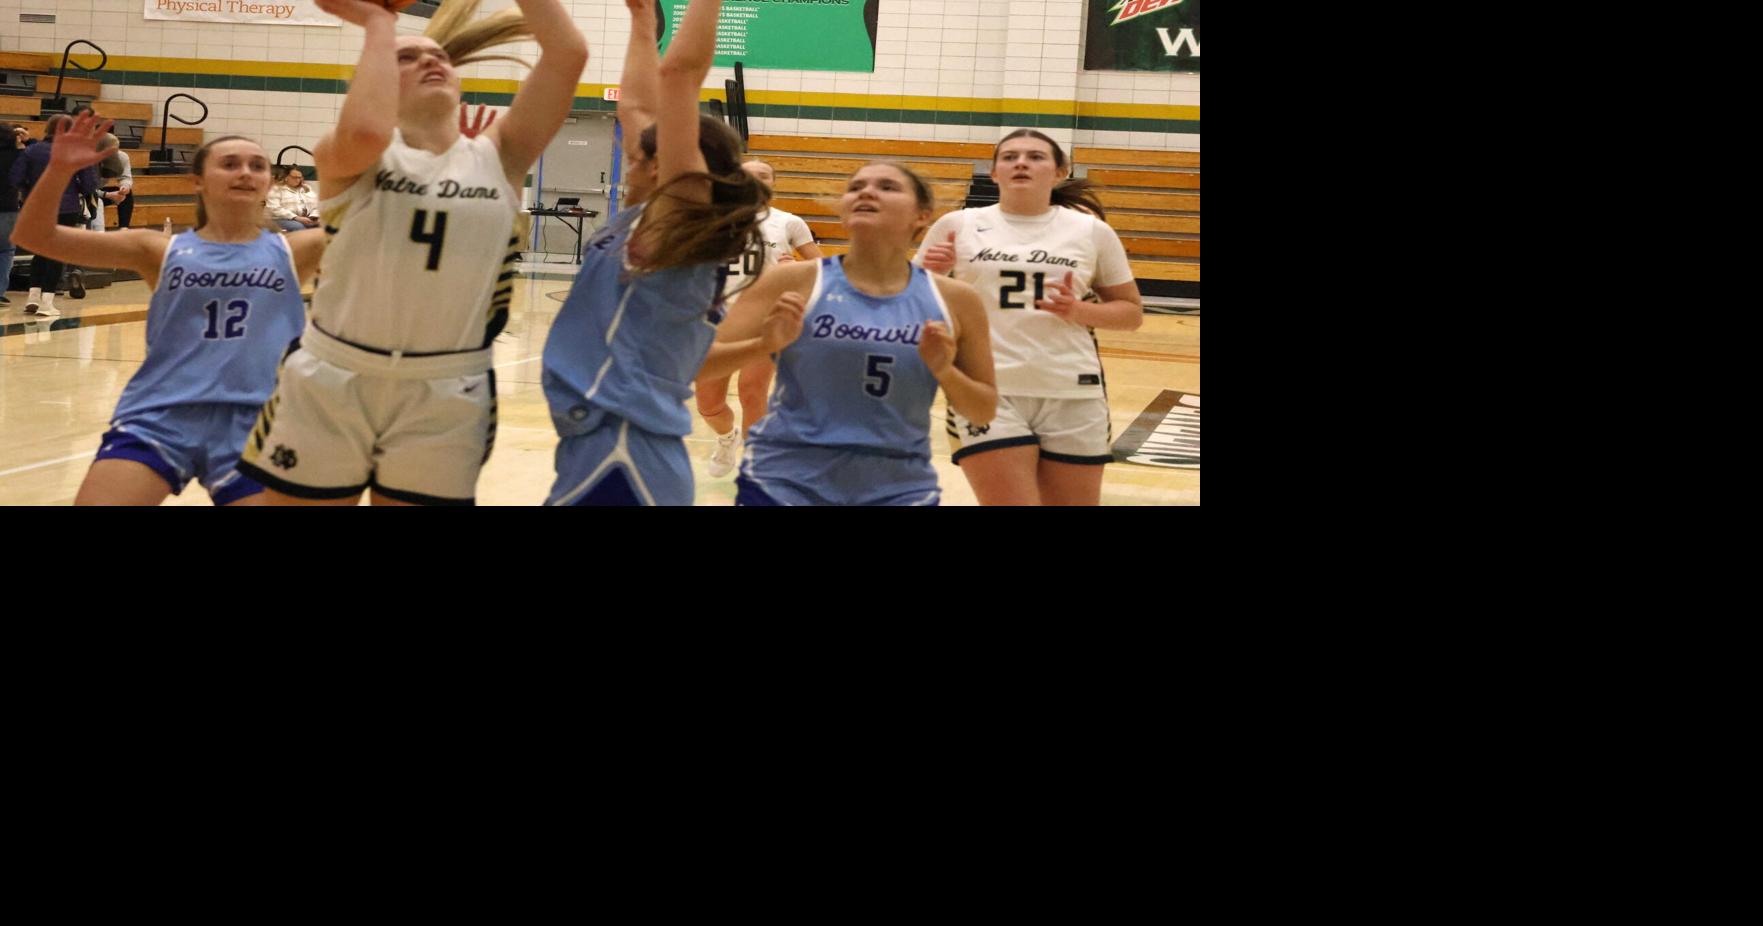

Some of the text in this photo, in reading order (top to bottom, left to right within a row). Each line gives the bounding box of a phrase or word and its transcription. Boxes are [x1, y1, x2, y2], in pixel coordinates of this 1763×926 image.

[156, 0, 296, 18] Physical Therapy
[437, 179, 499, 200] Dame
[409, 209, 448, 271] 4
[969, 248, 1078, 268] Notre Dame
[168, 266, 285, 292] Boonville
[1000, 270, 1045, 309] 21
[203, 299, 249, 340] 12
[813, 314, 919, 346] Boonvil
[864, 353, 895, 399] 5
